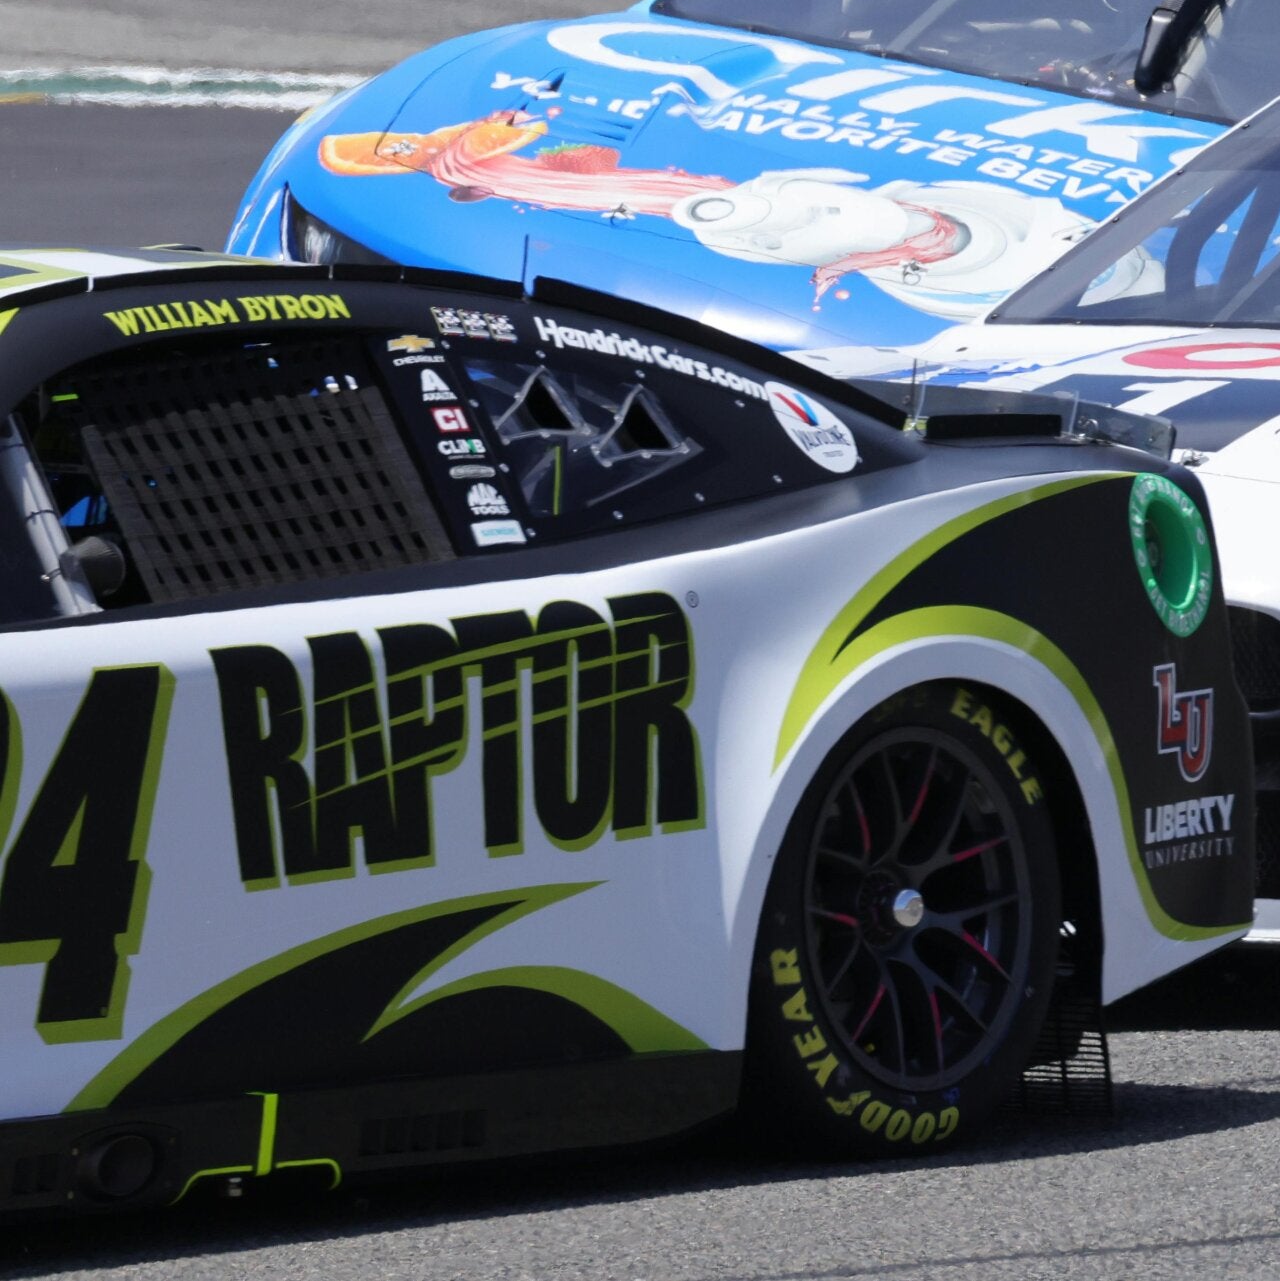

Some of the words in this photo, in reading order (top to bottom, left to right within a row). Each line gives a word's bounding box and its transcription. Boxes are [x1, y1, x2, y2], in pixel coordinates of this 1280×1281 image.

[935, 129, 1153, 195] WATER
[104, 298, 238, 335] WILLIAM
[237, 294, 351, 322] BYRON
[533, 316, 770, 401] HendrickCars.com
[471, 504, 511, 515] TOOLS
[949, 687, 1046, 806] EAGLE
[1153, 662, 1214, 783] LU
[0, 660, 177, 1045] 4
[208, 590, 706, 893] RAPTOR
[1144, 793, 1235, 844] LIBERTY
[1144, 835, 1235, 869] UNIVERSITY
